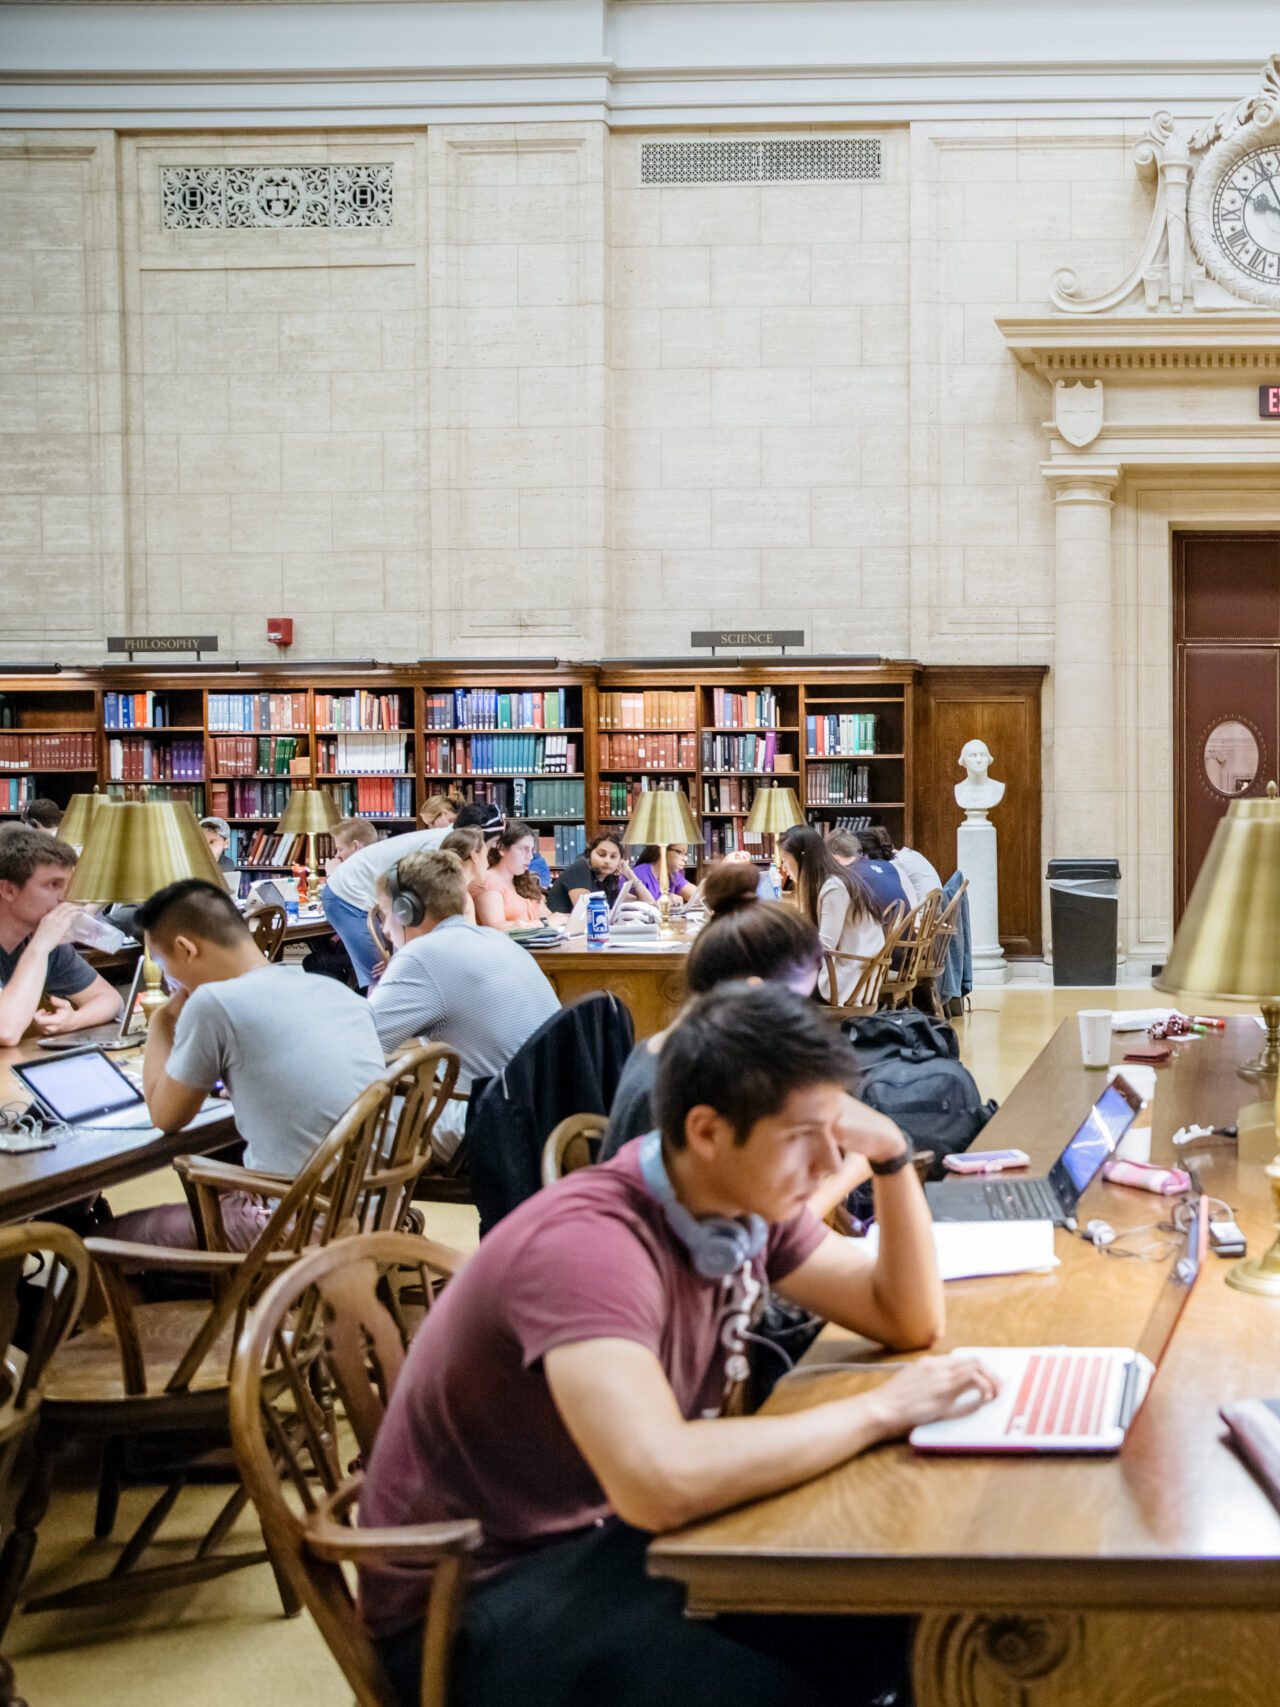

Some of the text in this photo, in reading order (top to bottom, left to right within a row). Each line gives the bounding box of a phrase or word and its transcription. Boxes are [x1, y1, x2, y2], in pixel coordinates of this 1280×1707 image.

[1221, 207, 1241, 221] IX
[1226, 229, 1250, 256] VIII
[1247, 248, 1268, 273] VII
[124, 639, 200, 649] PHILOSOPHY
[721, 633, 774, 644] SCIENCE
